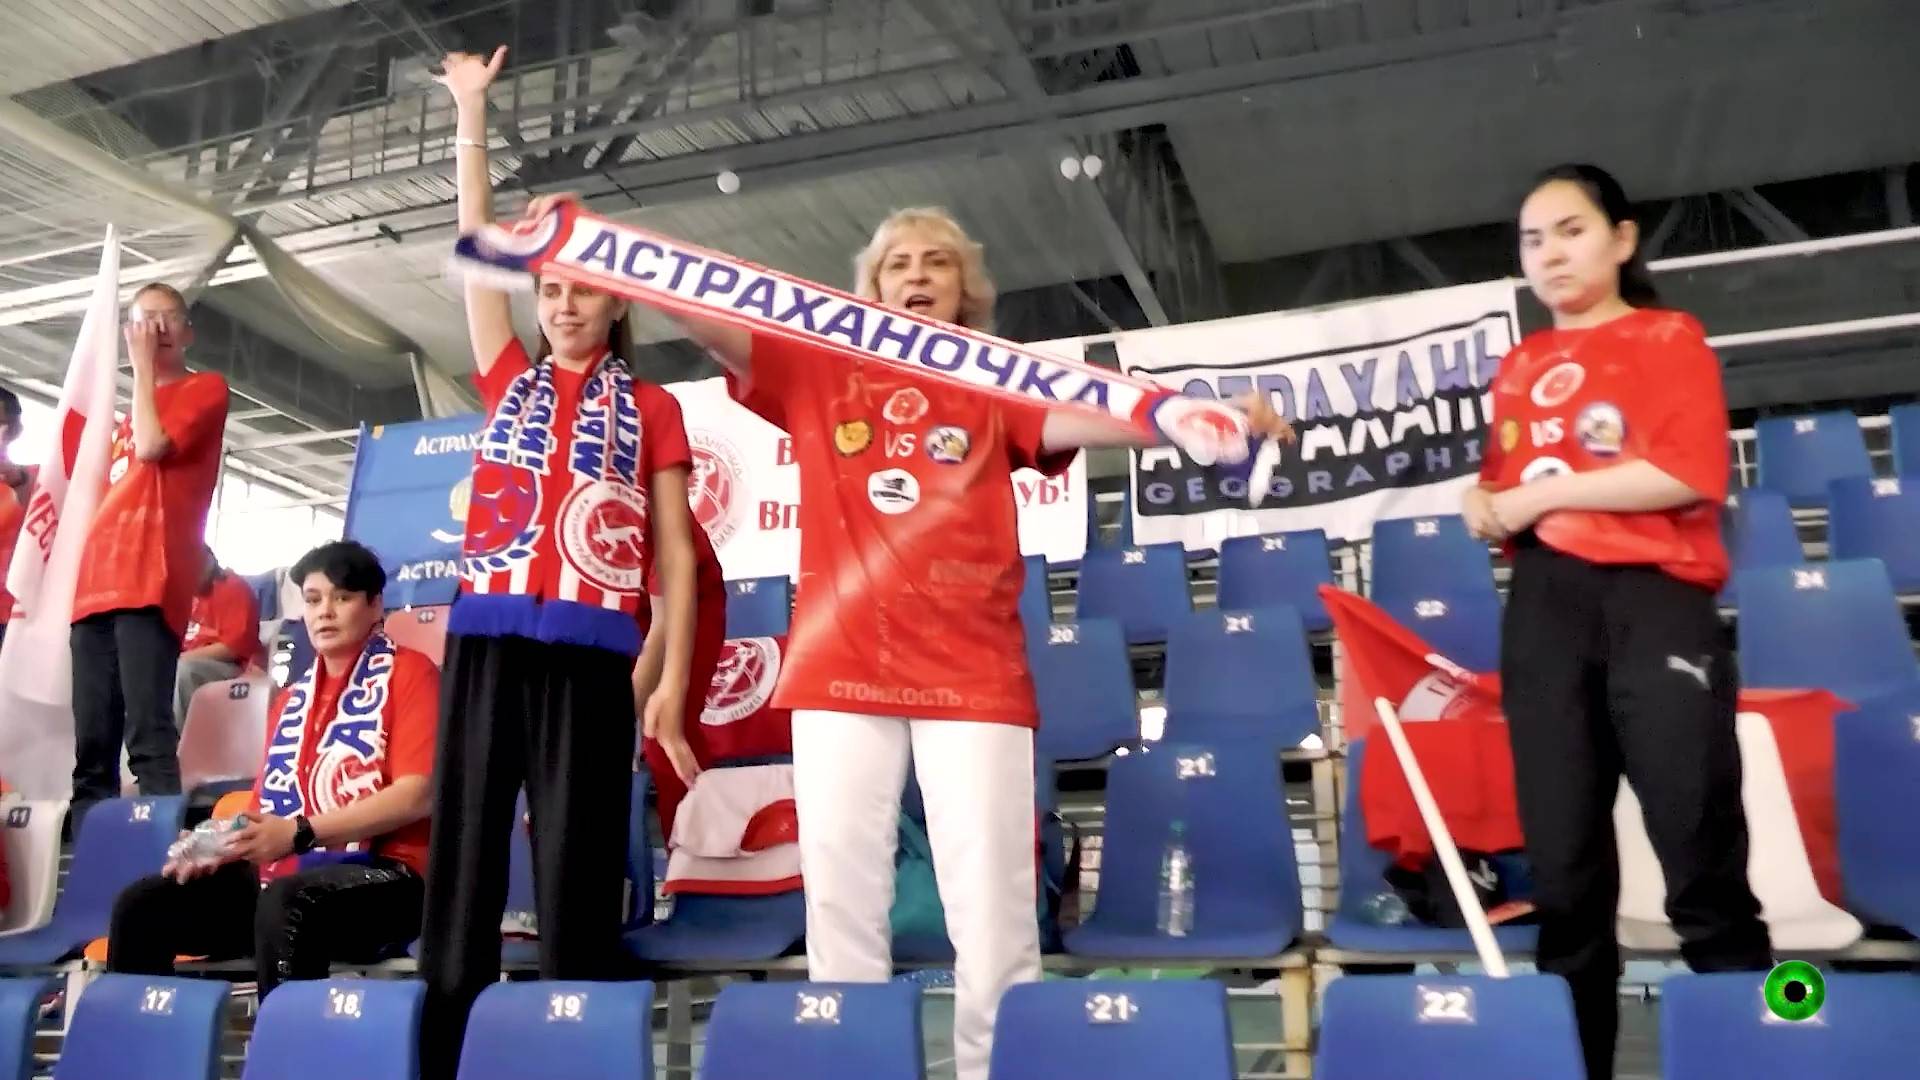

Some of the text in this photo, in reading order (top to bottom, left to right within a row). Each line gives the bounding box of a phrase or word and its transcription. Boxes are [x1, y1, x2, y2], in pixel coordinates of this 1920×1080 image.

[577, 229, 1110, 411] АСТРАХАНОЧКА
[1530, 417, 1564, 447] VS
[884, 431, 917, 459] VS
[1050, 629, 1074, 643] 20
[1178, 757, 1207, 777] 21
[147, 990, 171, 1010] 17
[333, 993, 358, 1014] 18
[551, 995, 580, 1017] 19
[801, 996, 837, 1019] 20
[1093, 995, 1128, 1020] 21
[1423, 991, 1468, 1019] 22
